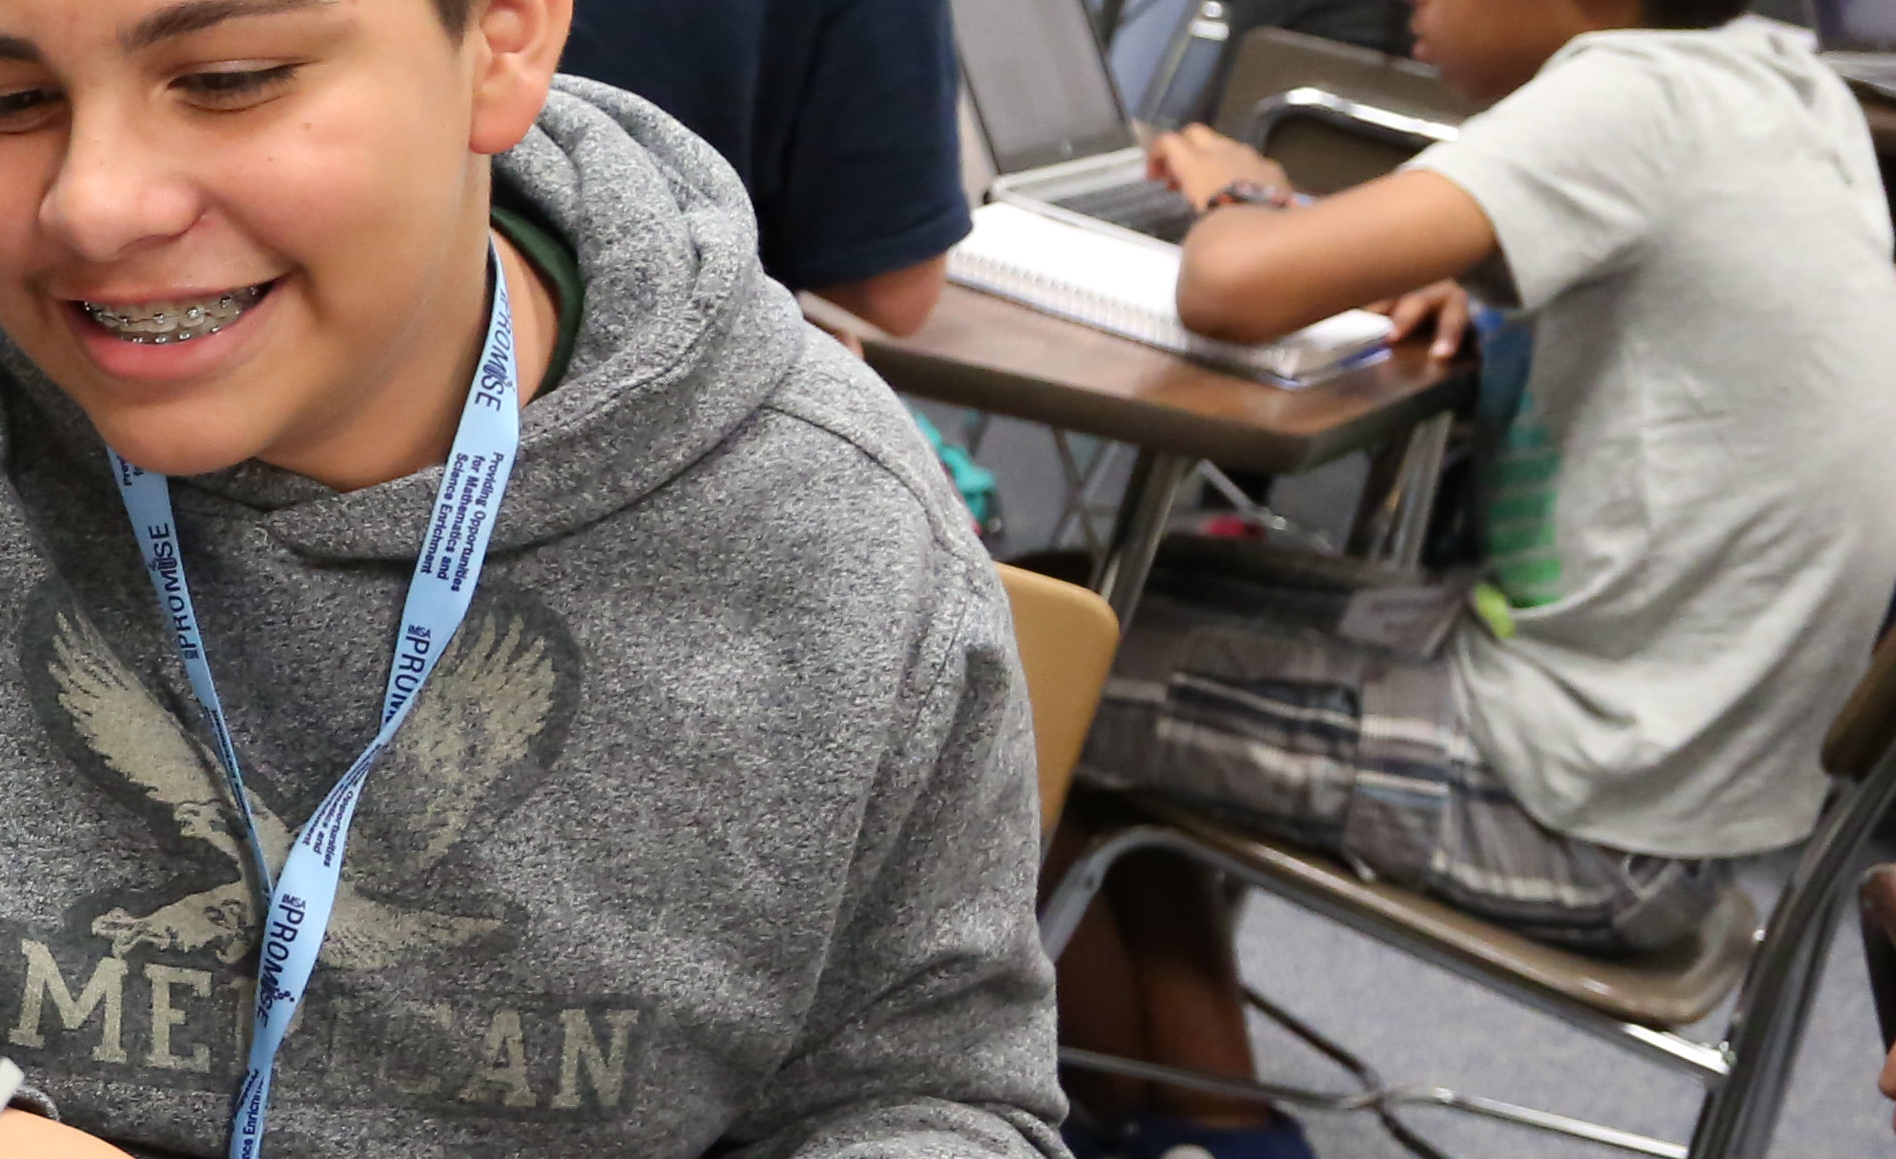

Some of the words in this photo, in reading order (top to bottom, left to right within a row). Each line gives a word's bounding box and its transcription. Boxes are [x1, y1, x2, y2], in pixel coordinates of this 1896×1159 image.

[443, 452, 469, 501] Science
[470, 454, 487, 474] for
[475, 451, 505, 508] Providing
[419, 503, 453, 575] Enrichment
[445, 474, 480, 553] Mathematics
[437, 555, 452, 581] and
[450, 509, 487, 592] Opportunities
[148, 522, 198, 653] PROMISE
[256, 904, 306, 1028] PROMISE
